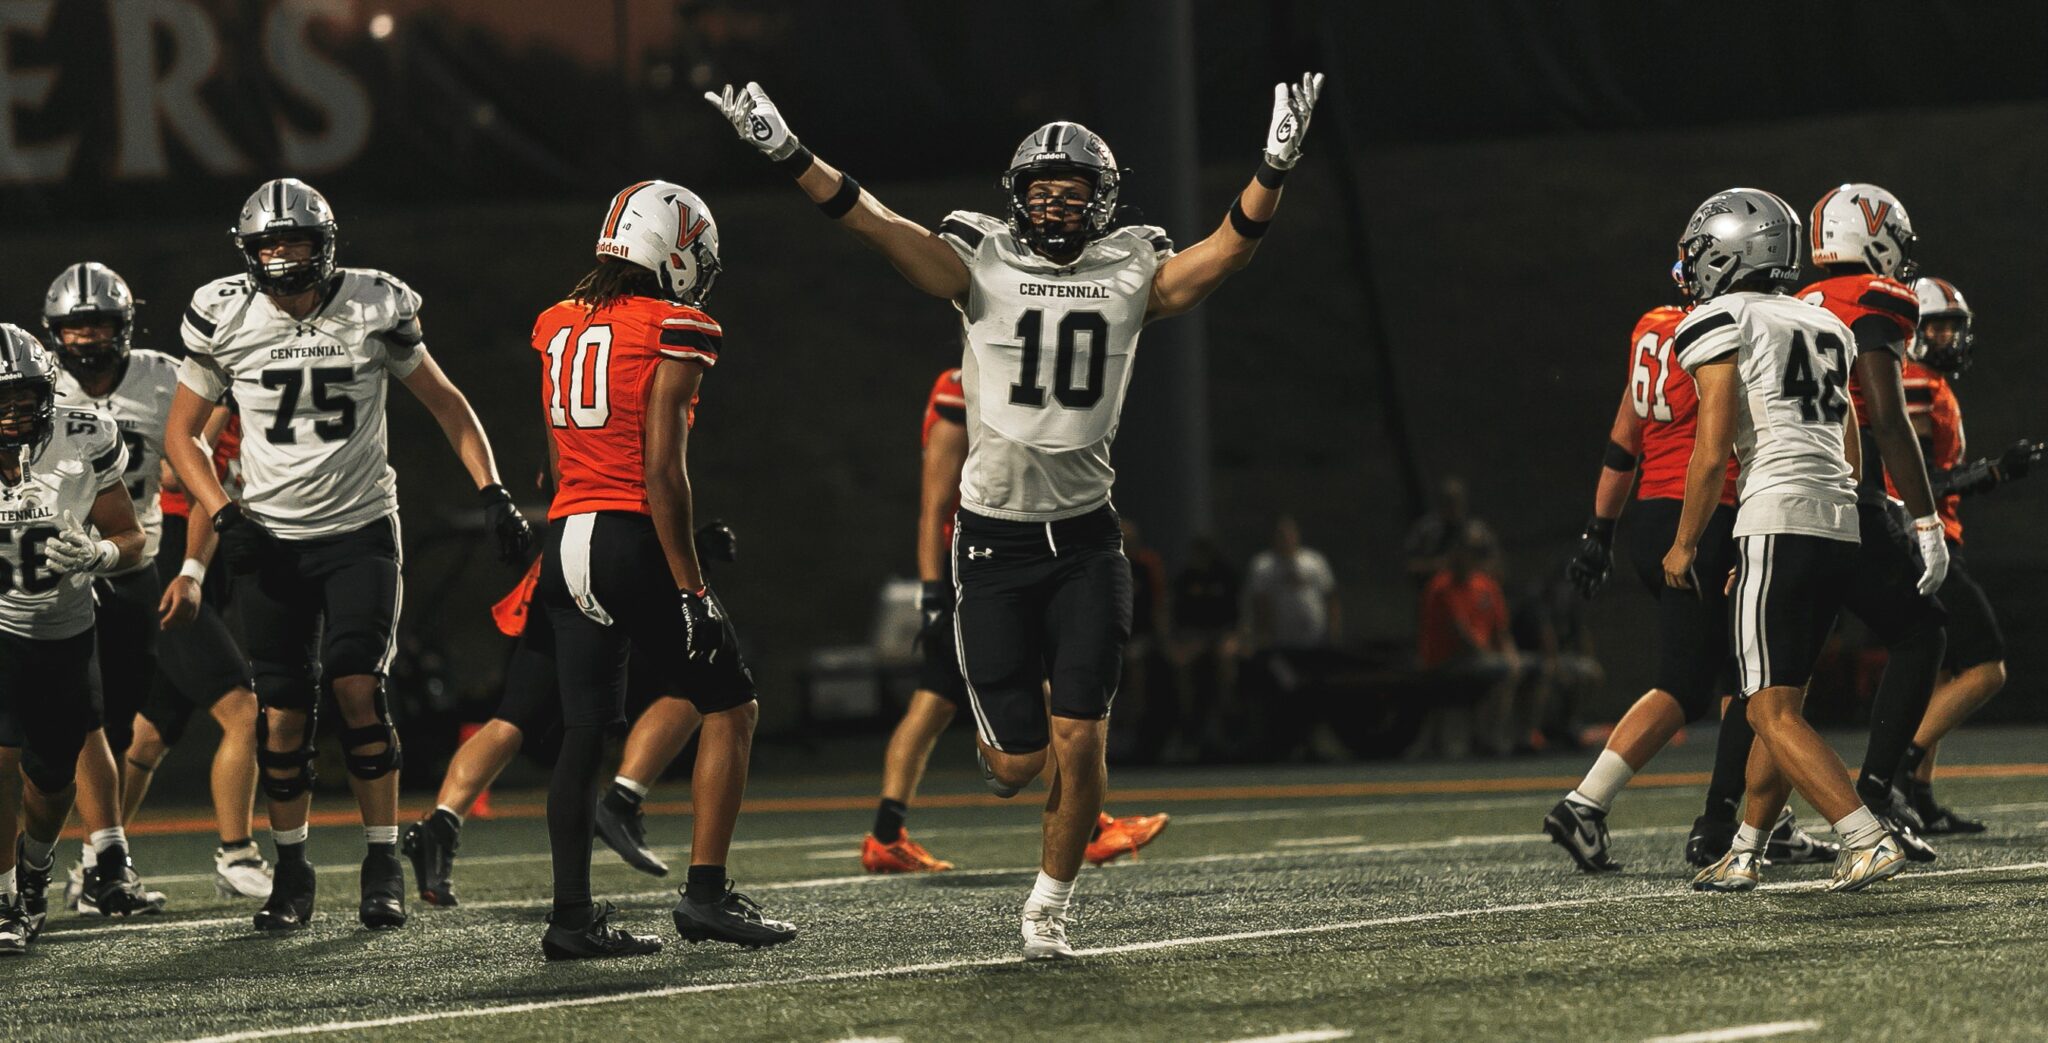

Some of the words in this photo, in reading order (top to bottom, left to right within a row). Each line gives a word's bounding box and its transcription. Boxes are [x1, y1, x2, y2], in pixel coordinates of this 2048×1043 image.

[1035, 152, 1066, 160] Riddell
[675, 199, 711, 251] V
[1858, 197, 1893, 236] V
[1019, 283, 1110, 299] CENTENNIAL
[270, 345, 345, 360] CENTENNIAL
[547, 323, 615, 430] 10
[1008, 307, 1110, 411] 10
[1631, 331, 1675, 422] 61
[1780, 329, 1850, 425] 42
[261, 367, 355, 445] 75
